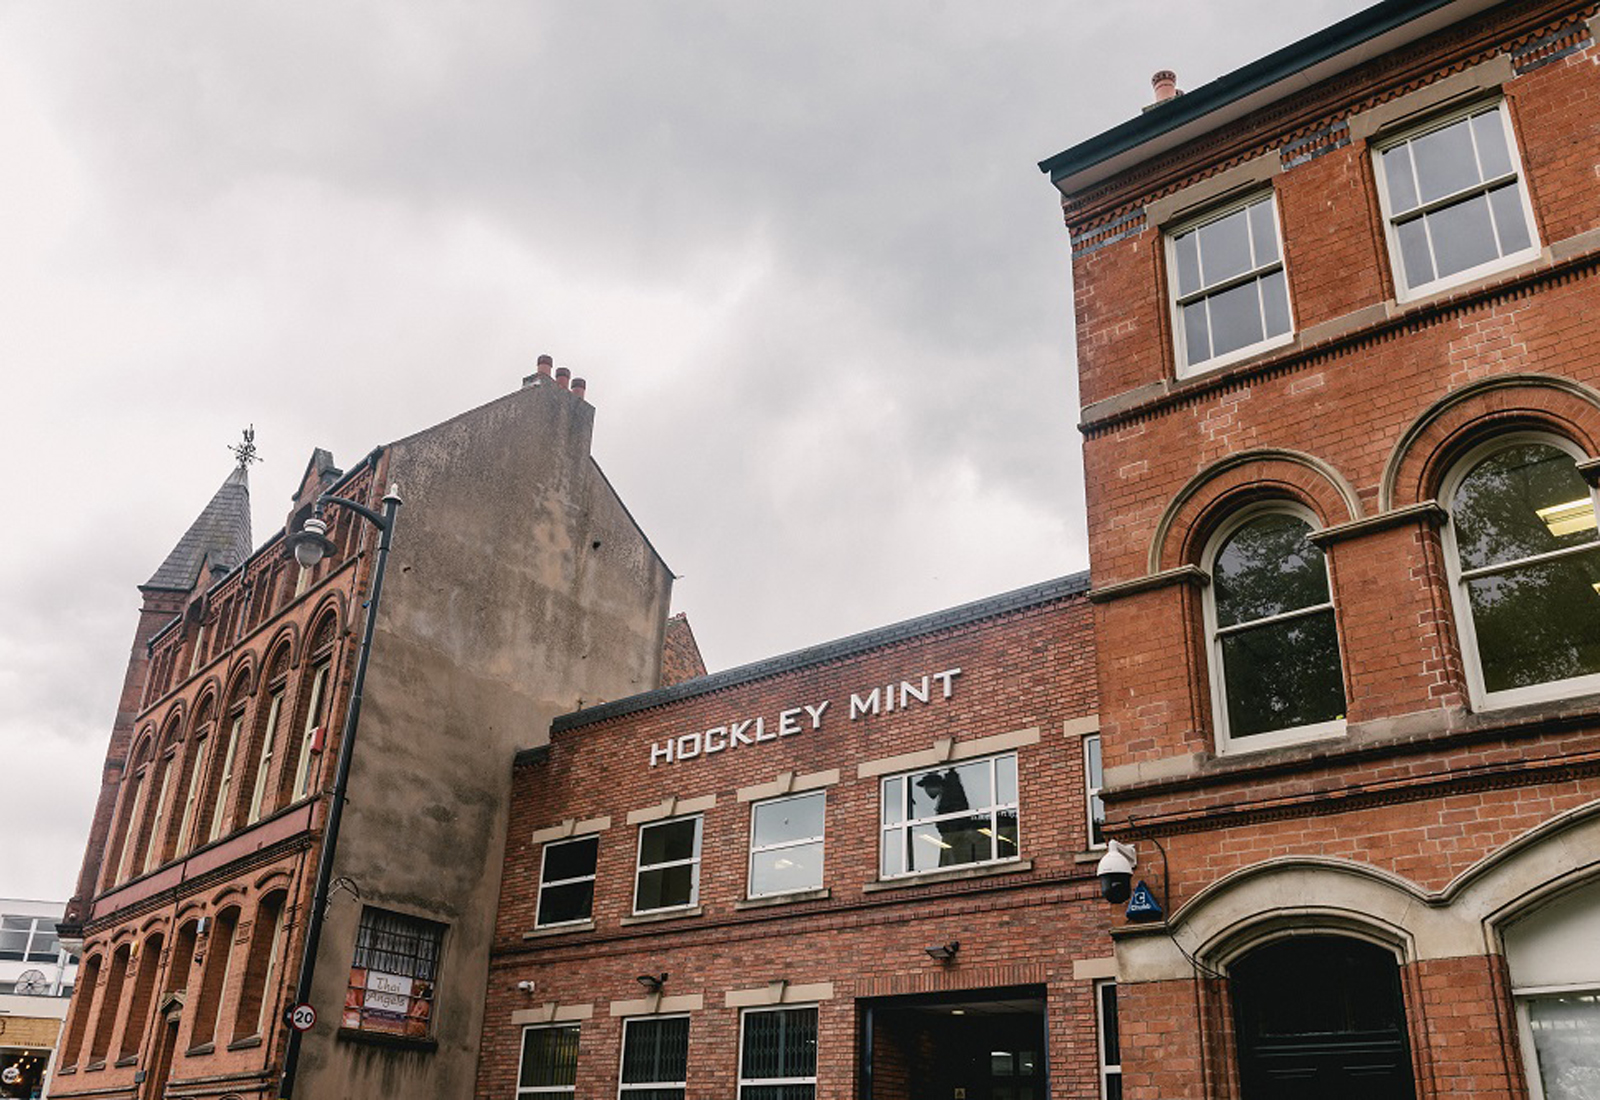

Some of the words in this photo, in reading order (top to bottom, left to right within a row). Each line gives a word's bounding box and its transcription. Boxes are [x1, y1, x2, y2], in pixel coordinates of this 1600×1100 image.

[649, 700, 830, 767] HOCKLEY
[849, 668, 962, 720] MINT
[376, 977, 402, 992] Thai
[365, 991, 406, 1008] Angels
[295, 1011, 313, 1024] 20
